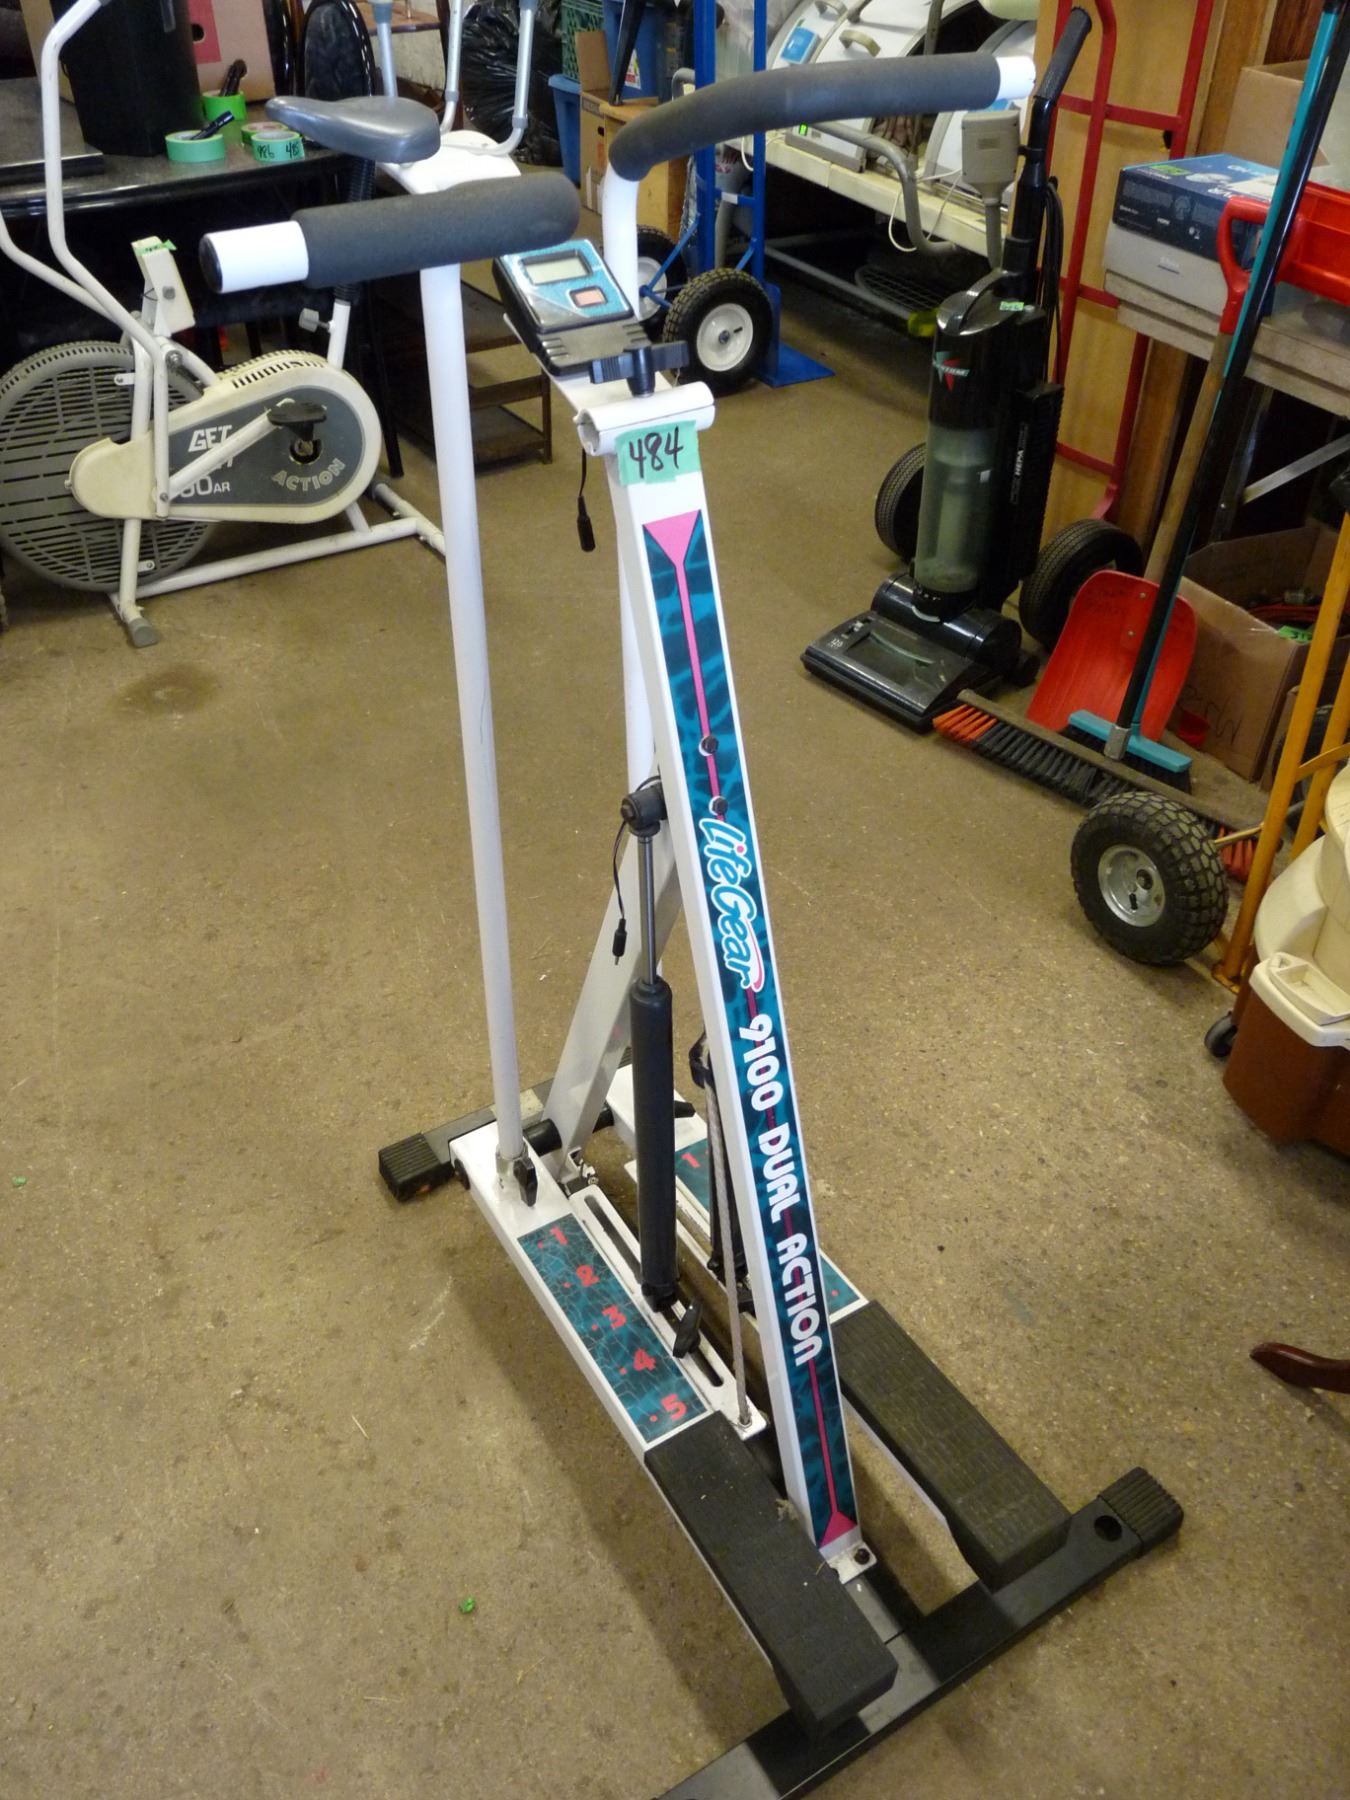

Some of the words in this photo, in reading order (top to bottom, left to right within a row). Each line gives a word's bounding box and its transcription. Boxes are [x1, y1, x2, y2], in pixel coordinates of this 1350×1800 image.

[188, 425, 232, 452] GET
[629, 425, 684, 479] 484
[272, 457, 346, 491] ACTION
[699, 818, 760, 990] LifeGear
[739, 1013, 784, 1113] 9100
[758, 1122, 801, 1224] DUAL
[550, 1226, 568, 1246] 1
[576, 1264, 600, 1287] 2
[776, 1232, 823, 1367] ACTION
[602, 1305, 627, 1329] 3
[633, 1348, 657, 1372] 4
[661, 1394, 688, 1420] 5
